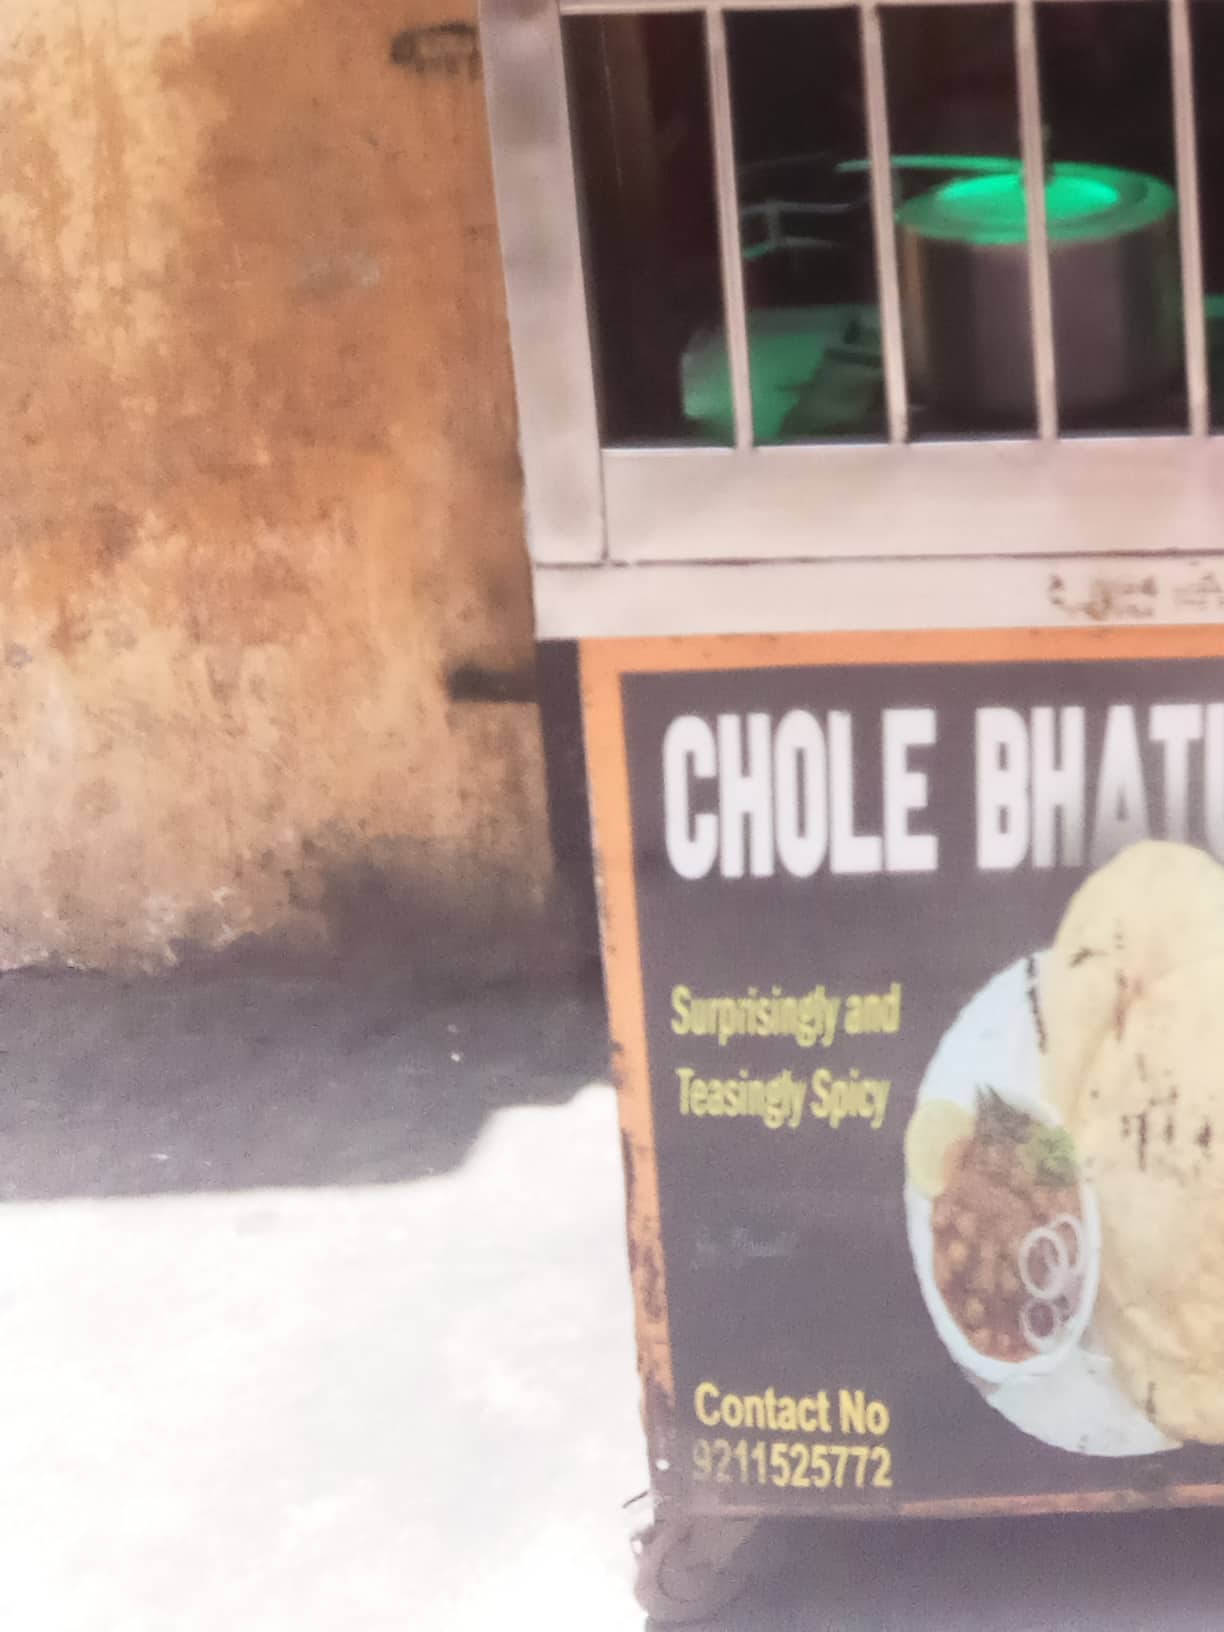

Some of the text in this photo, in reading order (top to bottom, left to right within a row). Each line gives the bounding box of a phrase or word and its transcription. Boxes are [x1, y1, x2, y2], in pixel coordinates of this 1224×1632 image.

[663, 708, 939, 879] CHOLE
[671, 982, 902, 1047] Surprisingly and
[675, 1067, 891, 1129] Teasingly Spicy
[693, 1381, 890, 1435] Contact No
[693, 1438, 894, 1488] 9211525772
